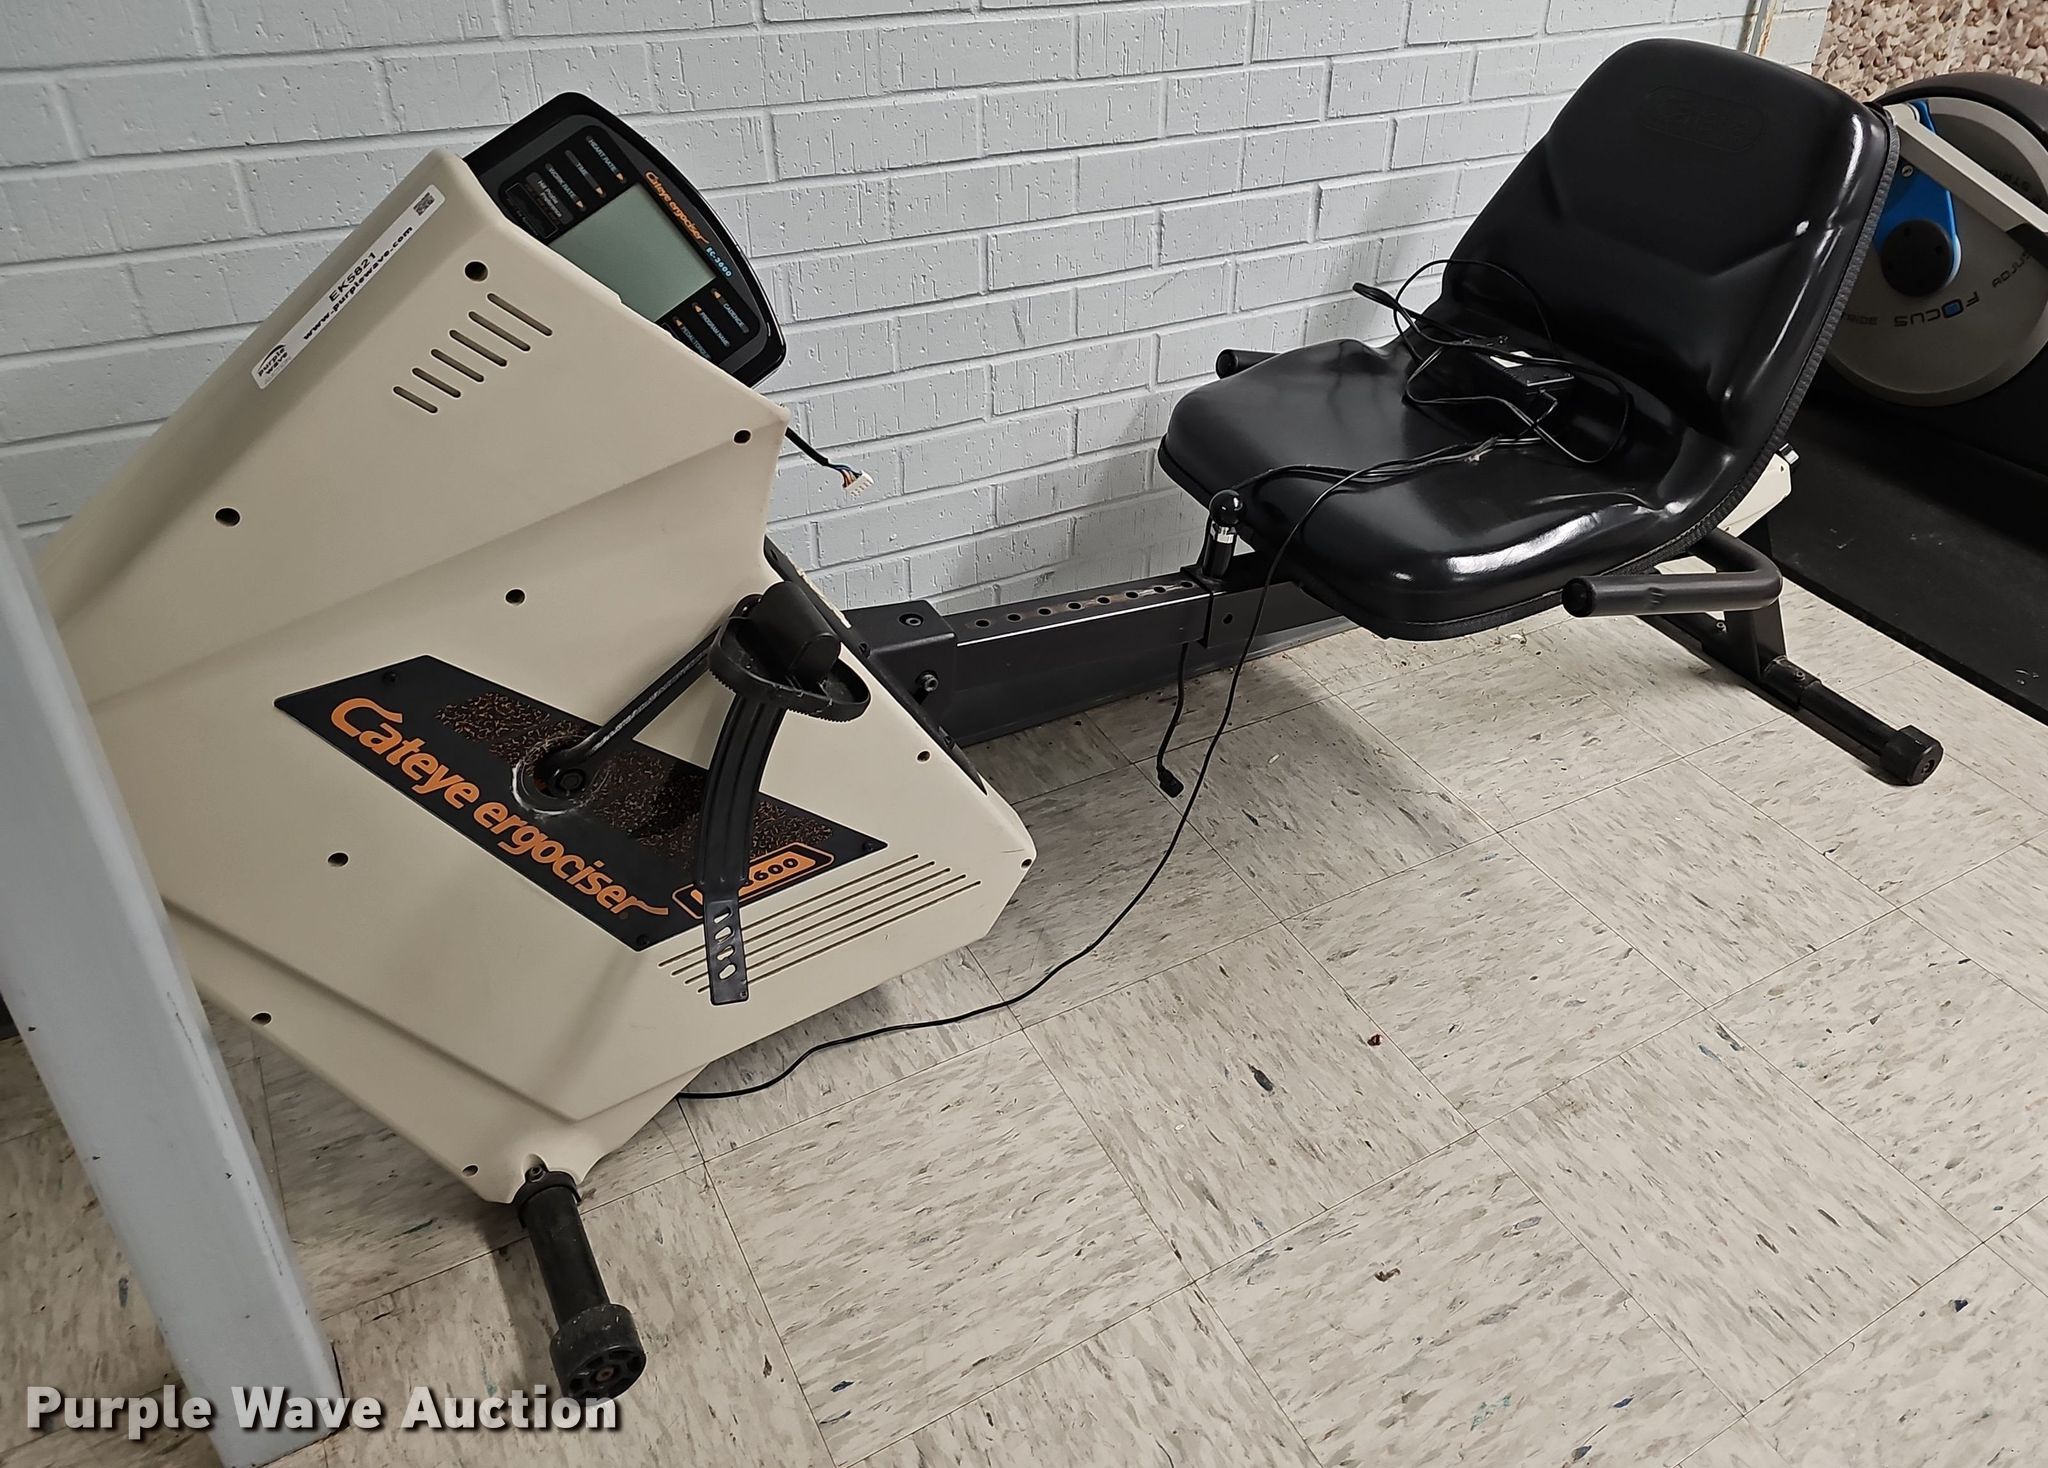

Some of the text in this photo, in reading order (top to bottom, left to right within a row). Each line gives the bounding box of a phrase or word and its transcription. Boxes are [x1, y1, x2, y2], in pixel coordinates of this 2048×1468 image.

[645, 171, 710, 244] Cateye ergociser
[303, 226, 413, 341] www.purplewave.com
[329, 251, 377, 302] EK5821
[723, 303, 745, 329] CADENCE
[1894, 291, 1980, 327] FOCUS
[257, 347, 286, 377] purple
[265, 352, 288, 375] wave
[330, 697, 669, 916] Cateye ergociser
